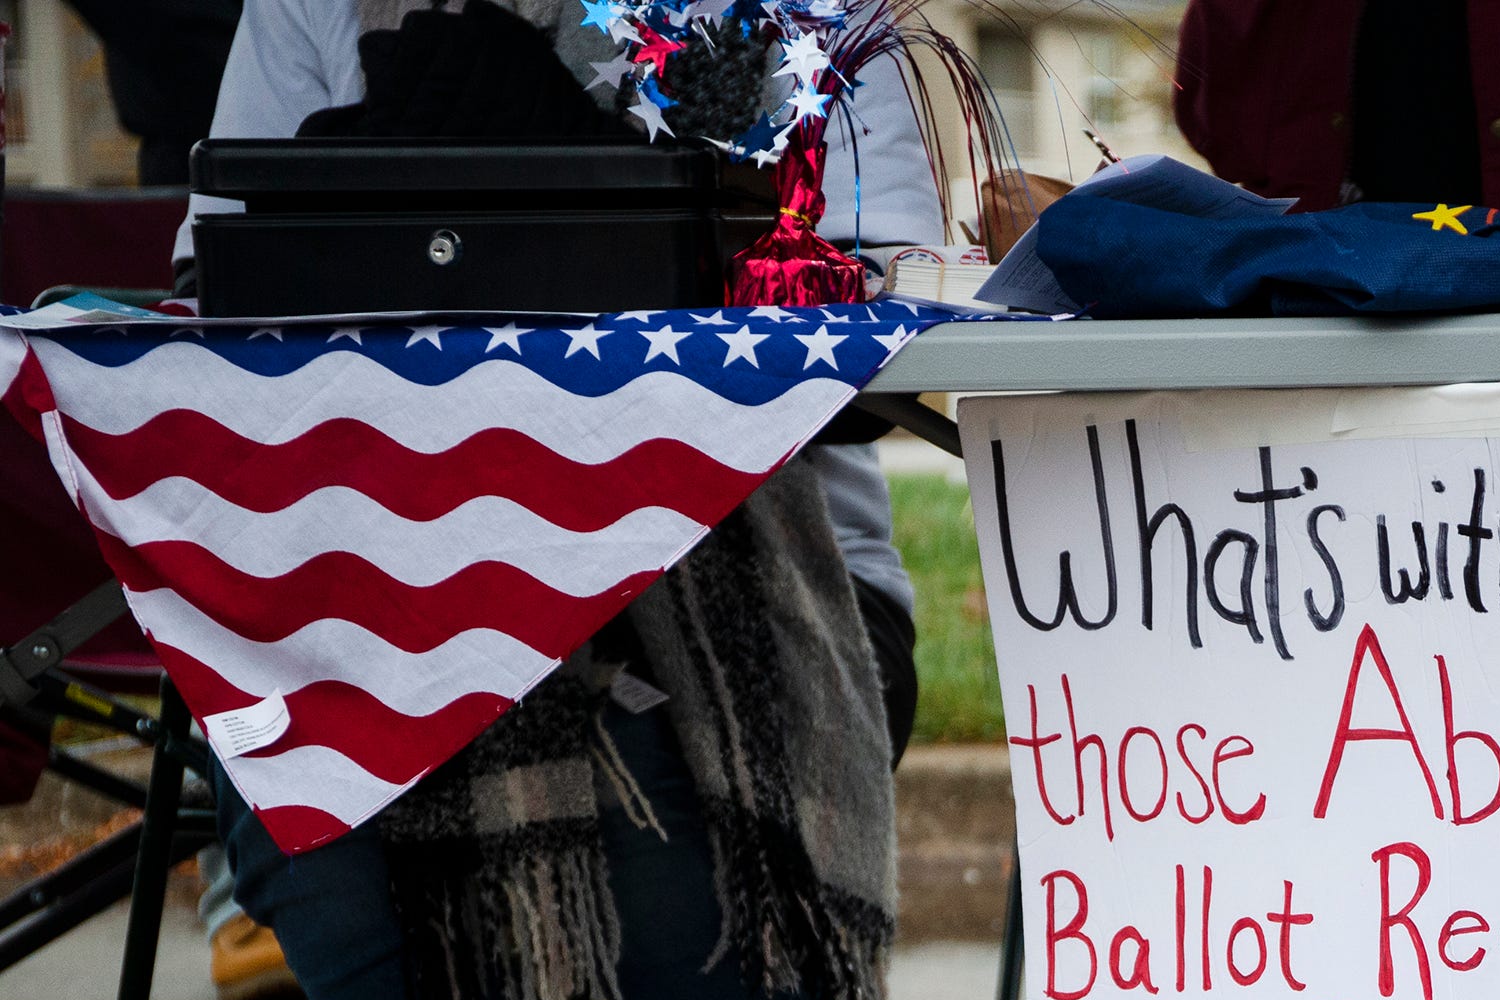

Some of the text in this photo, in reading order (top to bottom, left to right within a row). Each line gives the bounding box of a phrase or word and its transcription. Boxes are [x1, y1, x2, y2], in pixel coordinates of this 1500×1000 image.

[990, 416, 1347, 661] What's
[1009, 674, 1267, 842] those
[1041, 864, 1314, 1000] Ballot
